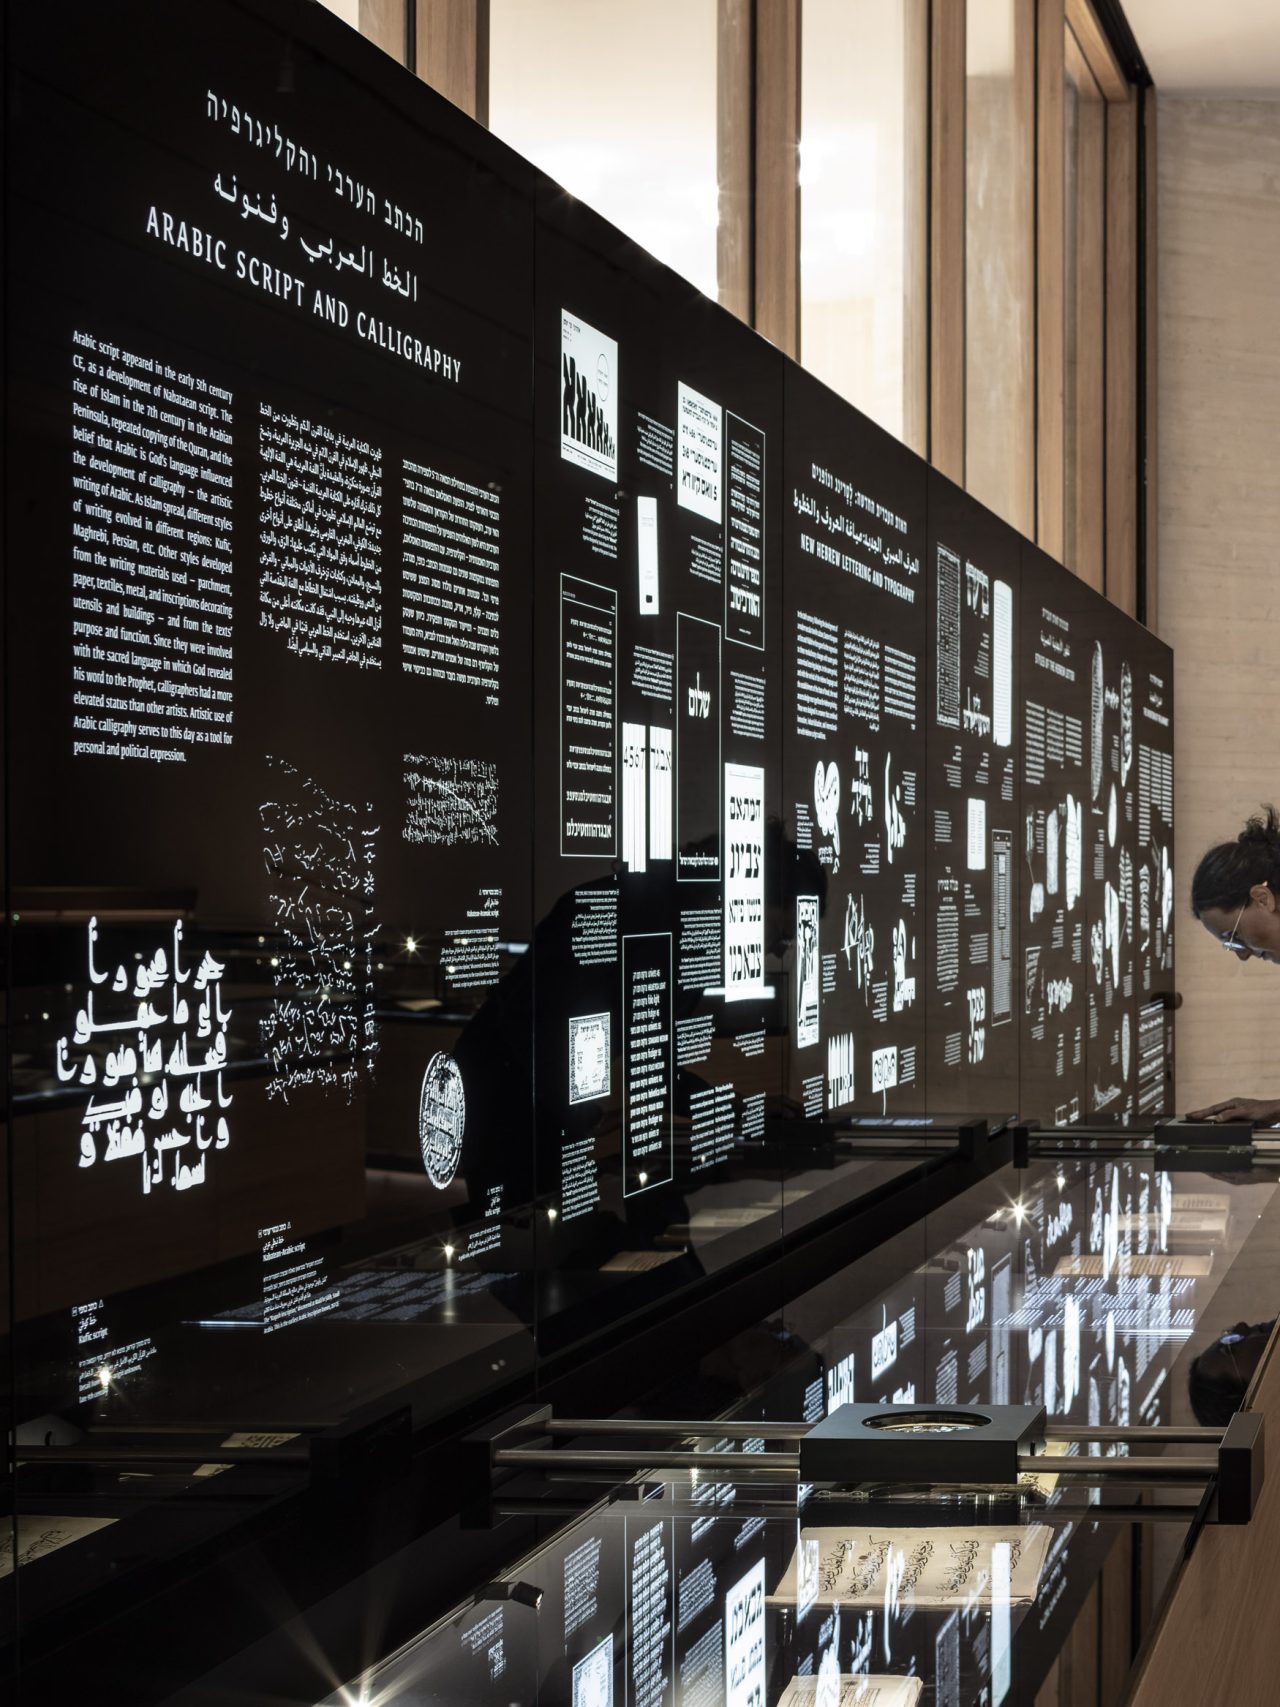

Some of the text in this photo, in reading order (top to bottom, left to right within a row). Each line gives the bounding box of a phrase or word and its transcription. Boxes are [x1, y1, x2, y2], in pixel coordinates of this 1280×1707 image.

[206, 89, 423, 245] הכתב הערבי והקליגרפיה
[213, 173, 418, 303] الخط العربي وفنونه
[146, 205, 463, 384] ARABIC SCRIPT AND CALLIGRAPHY
[72, 330, 233, 405] Arabic script appeared in the early 5th century
[72, 354, 233, 424] CE, development of Nabataean script. The
[72, 377, 232, 445] rise of Islam in the 7th century in the Arabian
[72, 402, 232, 466] Peninsula, repeated copying of the Quran, and the
[72, 450, 232, 509] the development of calligraphy the artistic
[73, 425, 232, 488] belief that Arabic God's language influenced
[72, 476, 233, 531] writing of Arabic. Islam spread, different styles
[73, 498, 232, 554] of writing evolved in different regions: Kufic,
[72, 523, 232, 574] Maghrebi, Persian, etc. Other styles developed
[73, 546, 232, 597] from the writing materials used parchment,
[800, 532, 816, 555] NEW
[816, 540, 841, 568] HEBREW
[841, 553, 872, 583] LETTERING
[872, 569, 884, 589] AND
[883, 574, 916, 604] TYPOGRAPHY
[73, 573, 233, 619] paper, textiles, metal, and inscriptions decorating
[73, 597, 233, 637] utensils and buildings and from the texts'
[73, 621, 232, 659] purpose and function. Since they were involved
[73, 642, 232, 680] with the sacred language in which God revealed
[73, 666, 233, 702] his word the Prophet, calligraphers had more
[73, 690, 233, 723] elevated status than other artists. Artistic use of
[688, 671, 711, 719] שלום
[73, 715, 233, 744] Arabic calligraphy serves this day tool for
[73, 741, 186, 763] personal and political expression.
[92, 1327, 108, 1339] script
